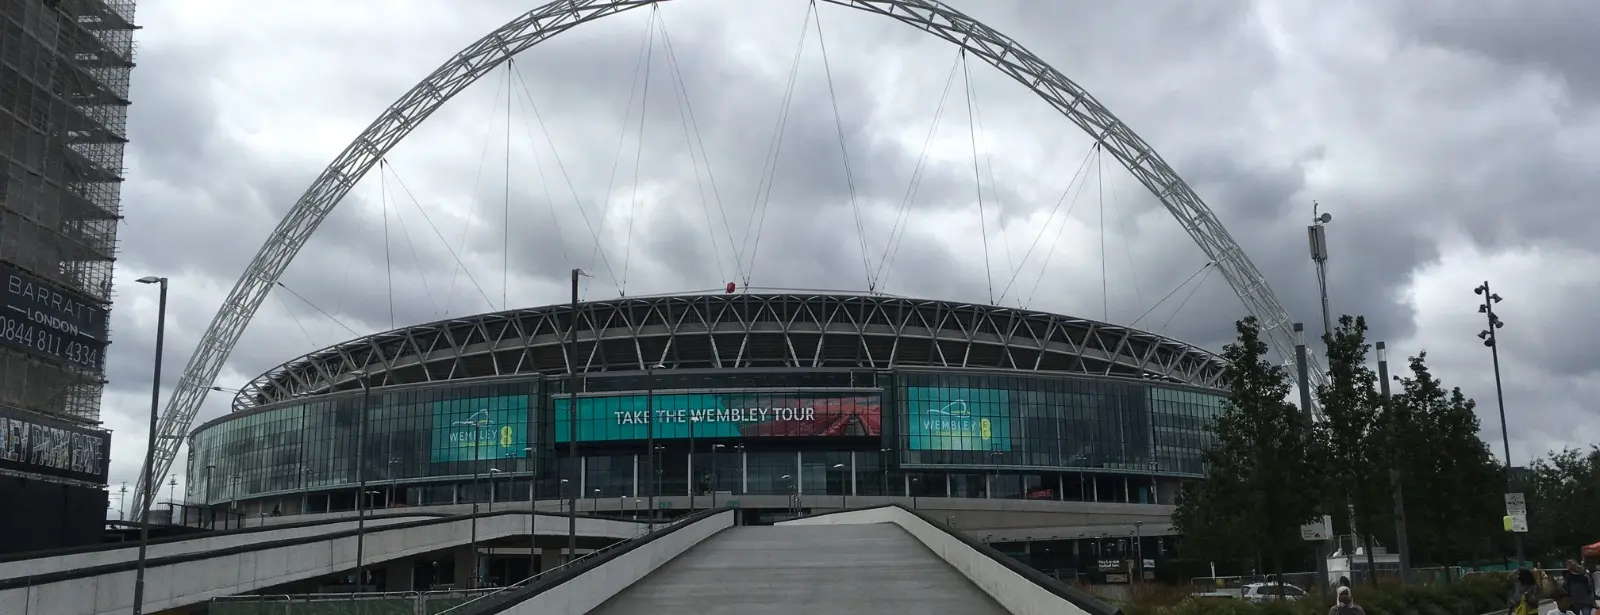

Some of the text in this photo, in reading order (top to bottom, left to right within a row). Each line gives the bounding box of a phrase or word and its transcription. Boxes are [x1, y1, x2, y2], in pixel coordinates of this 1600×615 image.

[8, 275, 96, 324] BARRATT
[27, 307, 78, 336] LONDON
[0, 316, 97, 368] 0844 811 4334
[614, 407, 815, 425] TAKE THE WEMBLEY TOUR
[923, 420, 976, 431] WEMBLEY
[0, 417, 103, 475] LEY PARK GATE
